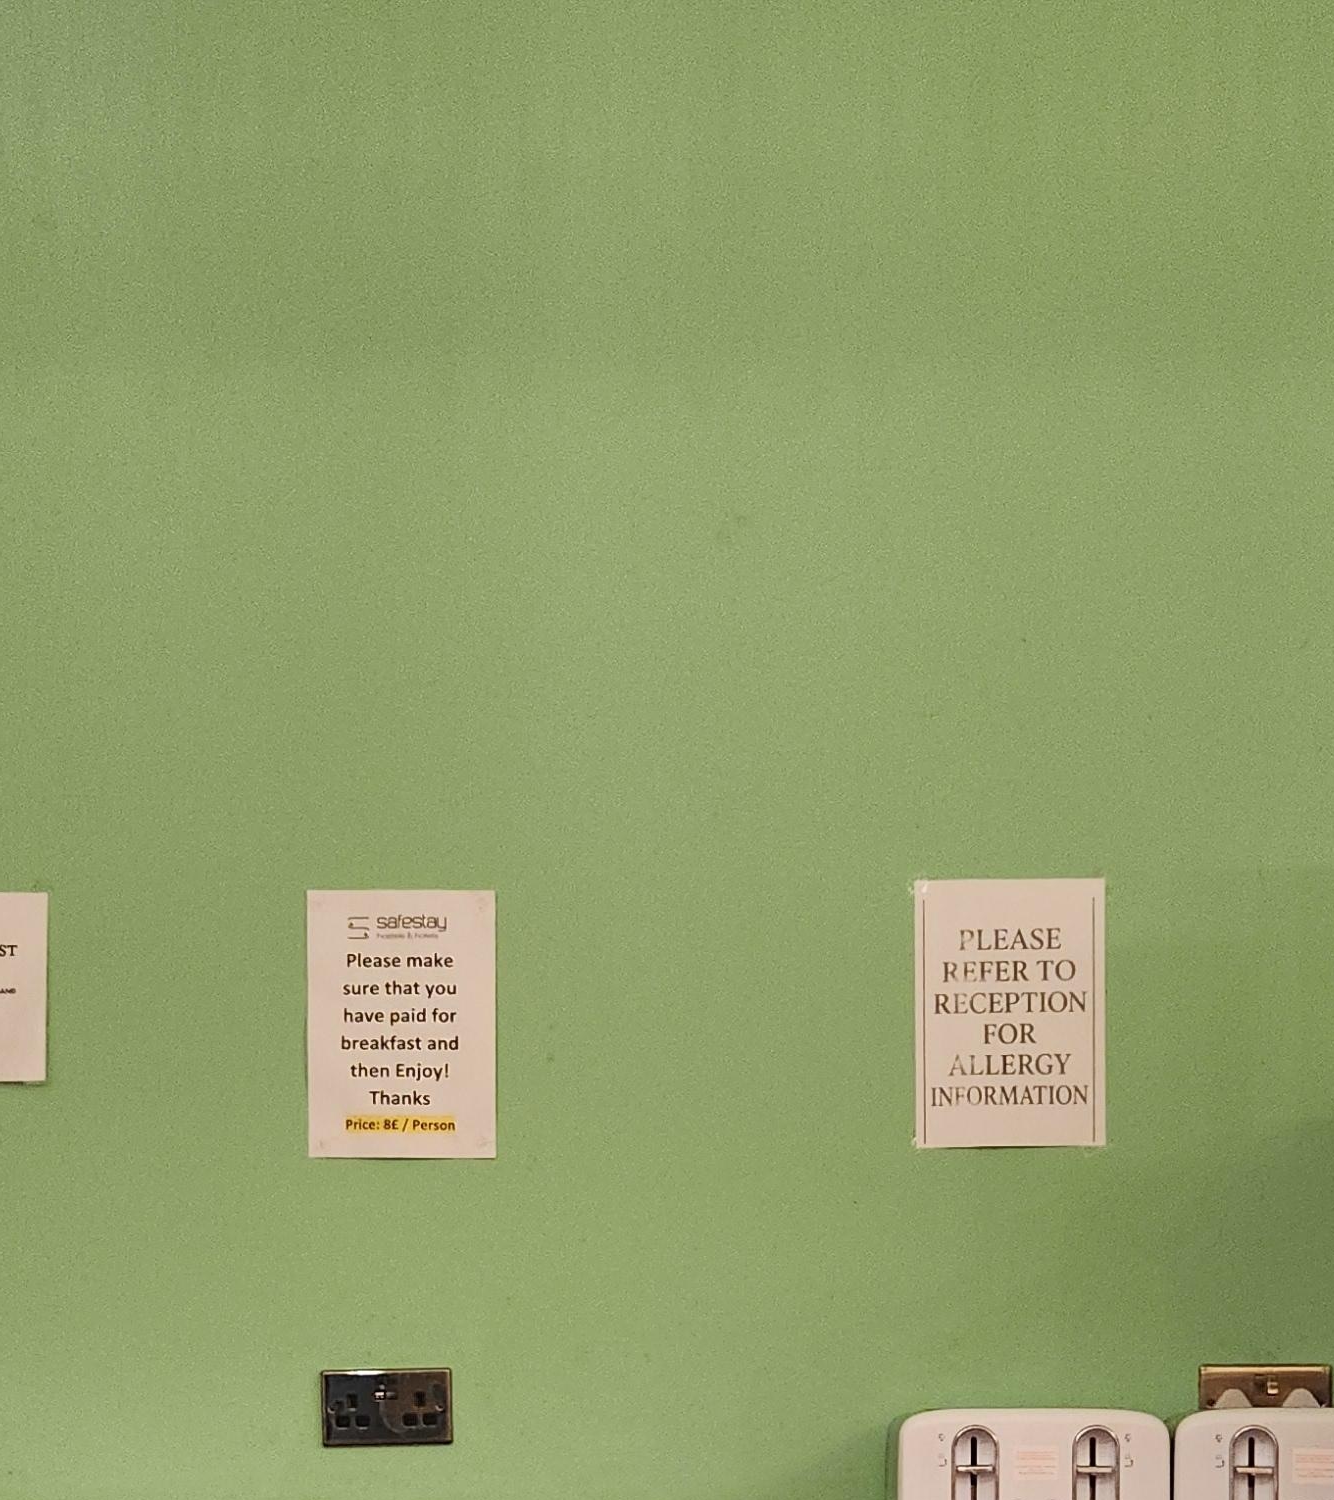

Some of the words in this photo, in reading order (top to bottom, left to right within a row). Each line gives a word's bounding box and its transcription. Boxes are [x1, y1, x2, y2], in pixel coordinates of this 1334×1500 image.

[376, 913, 448, 932] safestay
[959, 927, 1062, 952] PLEASE
[346, 952, 402, 969] Please
[406, 952, 454, 969] make
[942, 960, 1030, 984] REFER
[1035, 959, 1077, 982] TO
[342, 983, 380, 996] sure
[384, 980, 421, 996] that
[425, 983, 457, 999] you
[933, 990, 1088, 1015] RECEPTION
[343, 1007, 385, 1024] have
[389, 1007, 427, 1027] paid
[432, 1007, 457, 1024] for
[340, 1034, 423, 1051] breakfast
[427, 1034, 459, 1051] and
[983, 1022, 1038, 1045] FOR
[350, 1062, 390, 1079] then
[395, 1062, 449, 1082] Enjoy!
[948, 1052, 1073, 1077] ALLERGY
[368, 1089, 431, 1106] Thanks
[930, 1084, 1089, 1108] INFORMATION
[345, 1118, 381, 1131] Price:
[401, 1118, 409, 1133] /
[412, 1118, 456, 1132] Person
